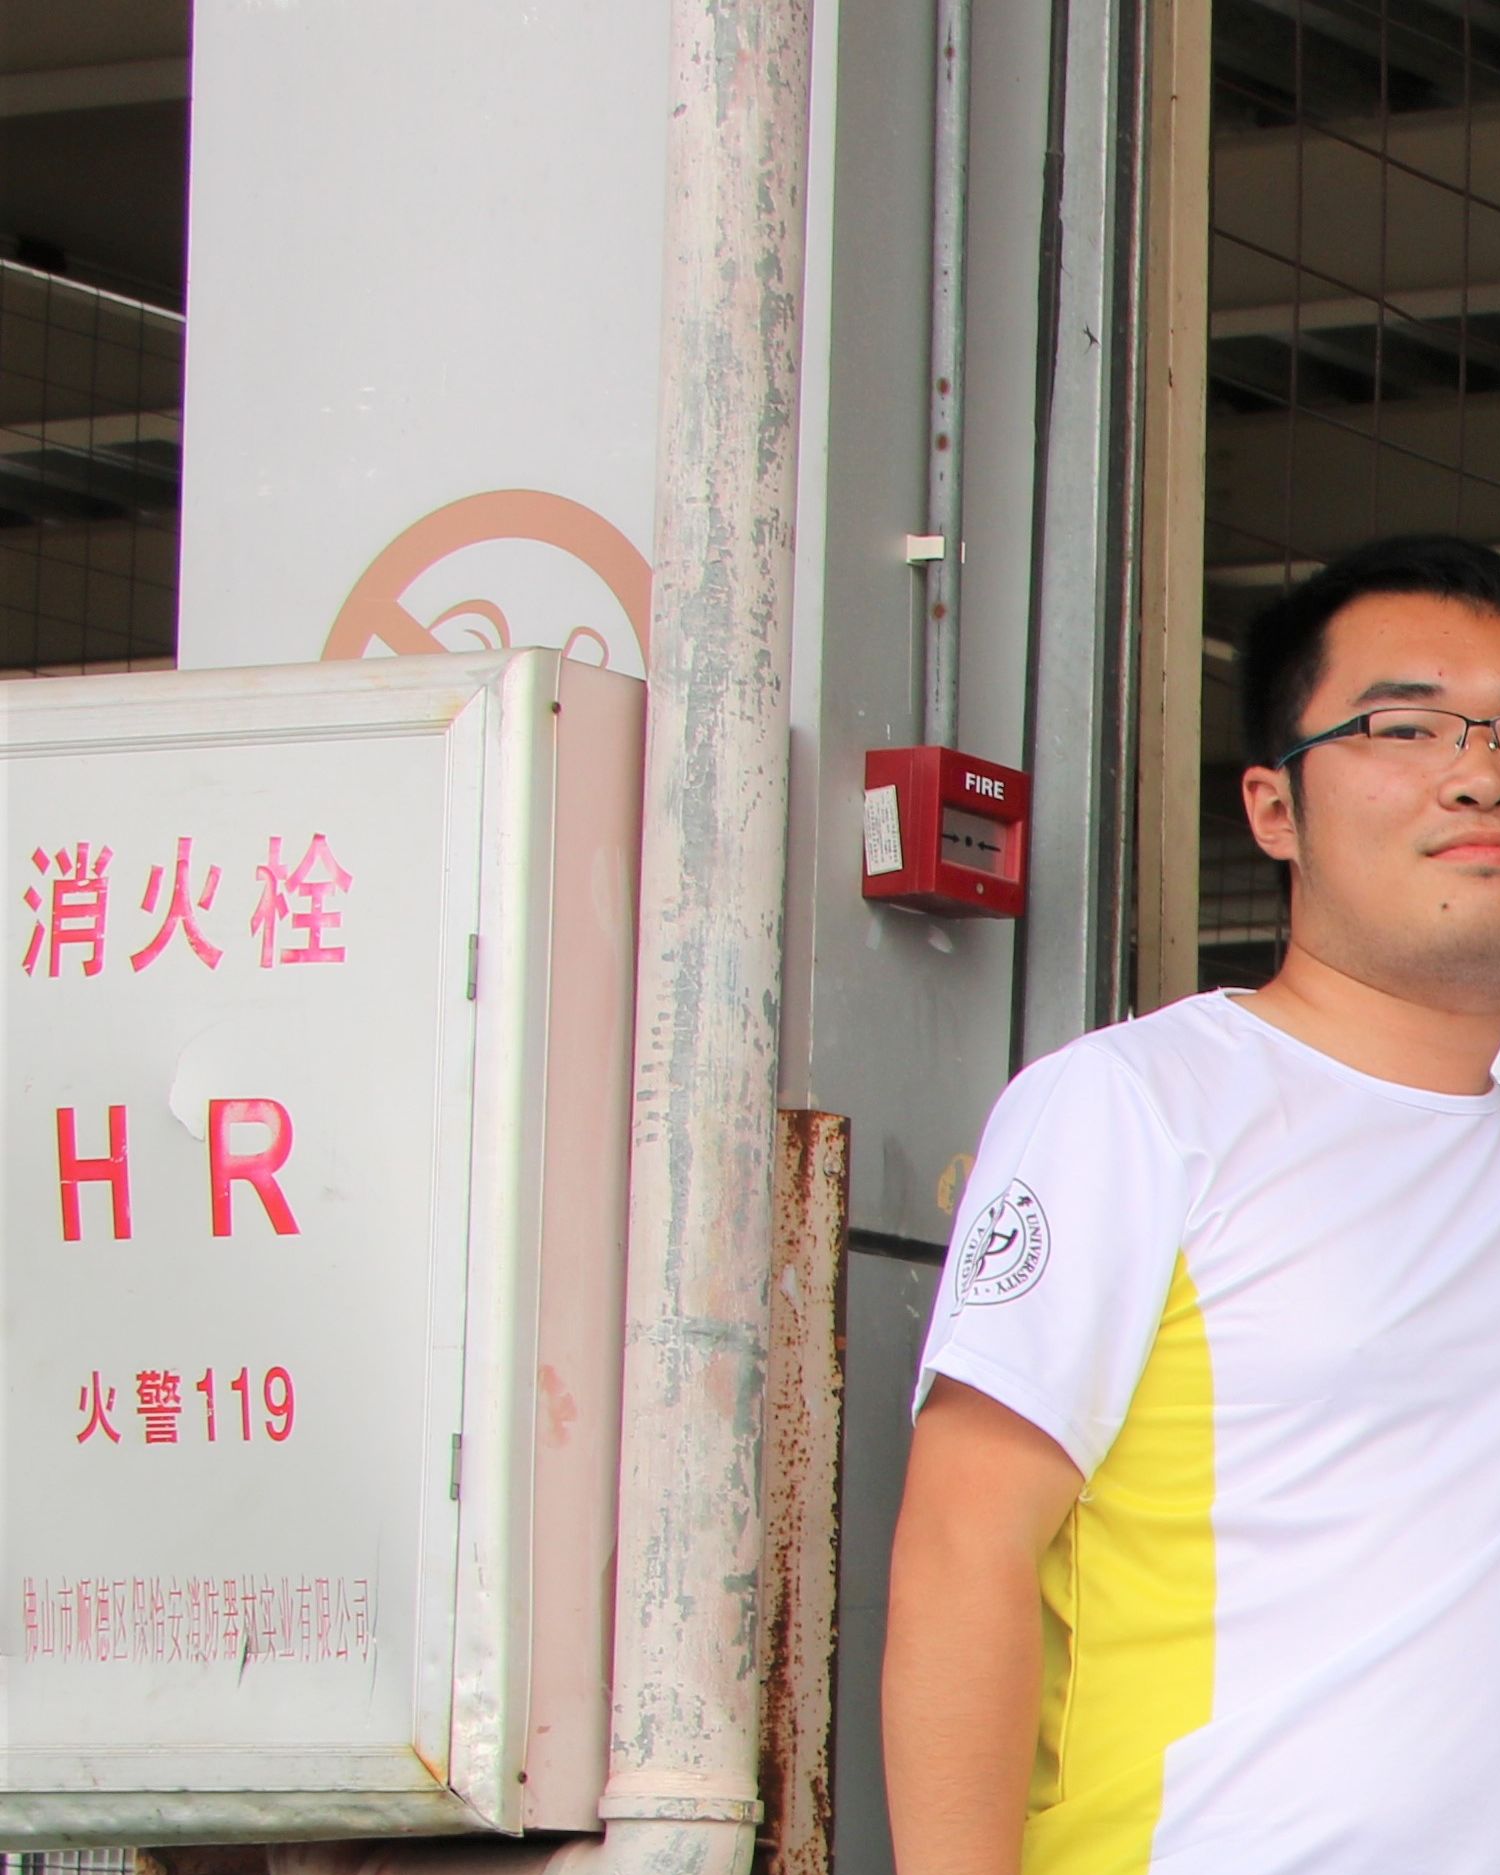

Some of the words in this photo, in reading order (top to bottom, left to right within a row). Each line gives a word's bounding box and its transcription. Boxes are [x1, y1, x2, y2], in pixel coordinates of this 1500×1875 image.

[965, 771, 1005, 801] FIRE
[21, 832, 354, 978] 消火栓
[56, 1104, 132, 1243] H
[207, 1097, 302, 1237] R
